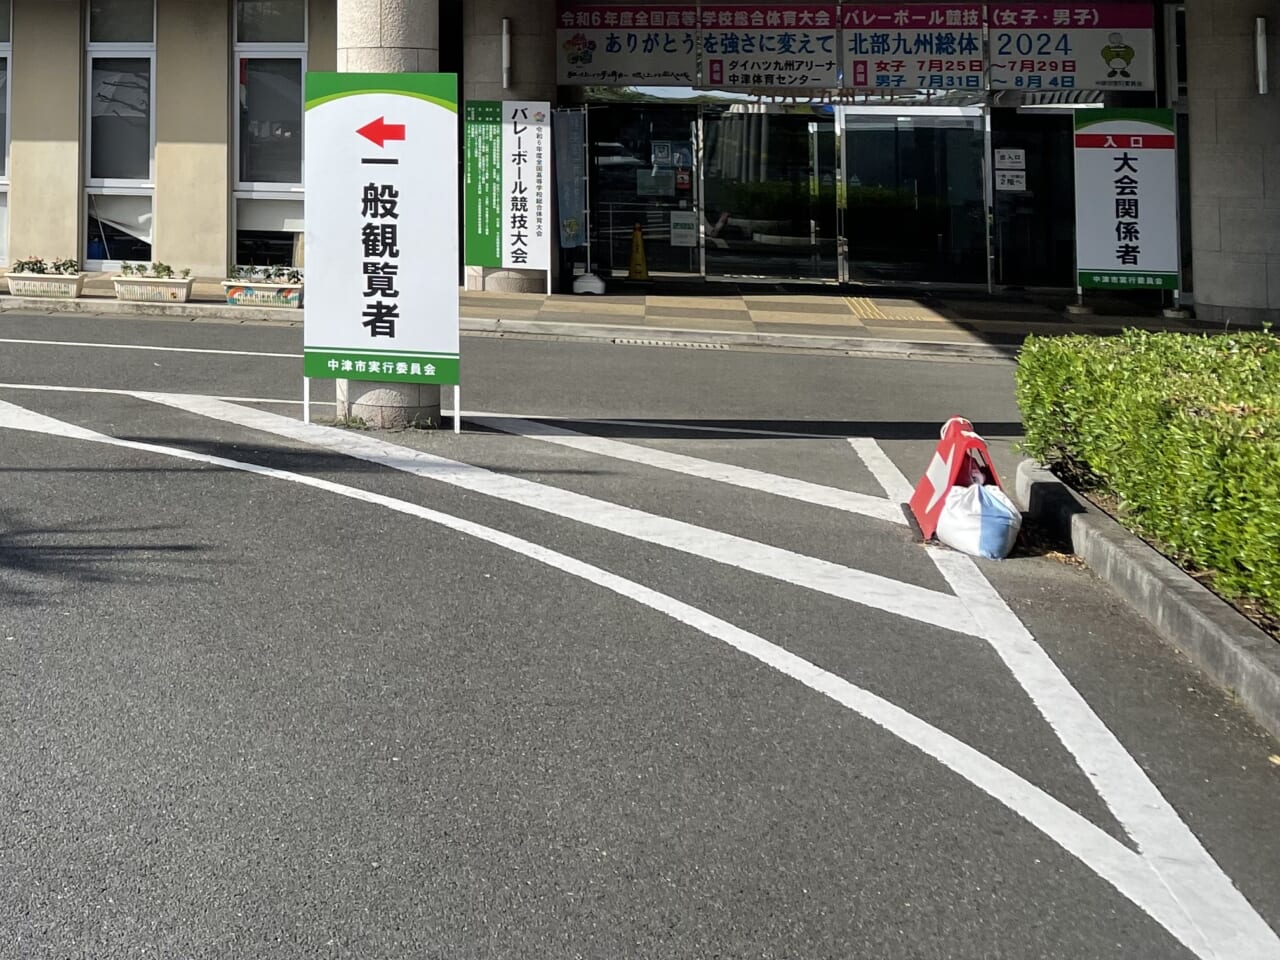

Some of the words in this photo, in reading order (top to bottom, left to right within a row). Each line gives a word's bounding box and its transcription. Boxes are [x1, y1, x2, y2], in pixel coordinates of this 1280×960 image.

[605, 31, 835, 55] ありがとうを強さに変えて
[848, 32, 979, 55] 北部九州総体
[997, 33, 1073, 56] 2024
[728, 60, 837, 72] ダイハツ九州アリーナ
[874, 60, 907, 72] 女子
[728, 74, 822, 85] 中津体育センター
[875, 75, 907, 87] 男子
[1103, 135, 1144, 148] 入口
[510, 107, 529, 264] バレーボール競技大会
[1113, 152, 1141, 266] 大会関係者
[360, 157, 400, 339] 一般観覧者
[327, 358, 437, 376] 中津市実行委員会
